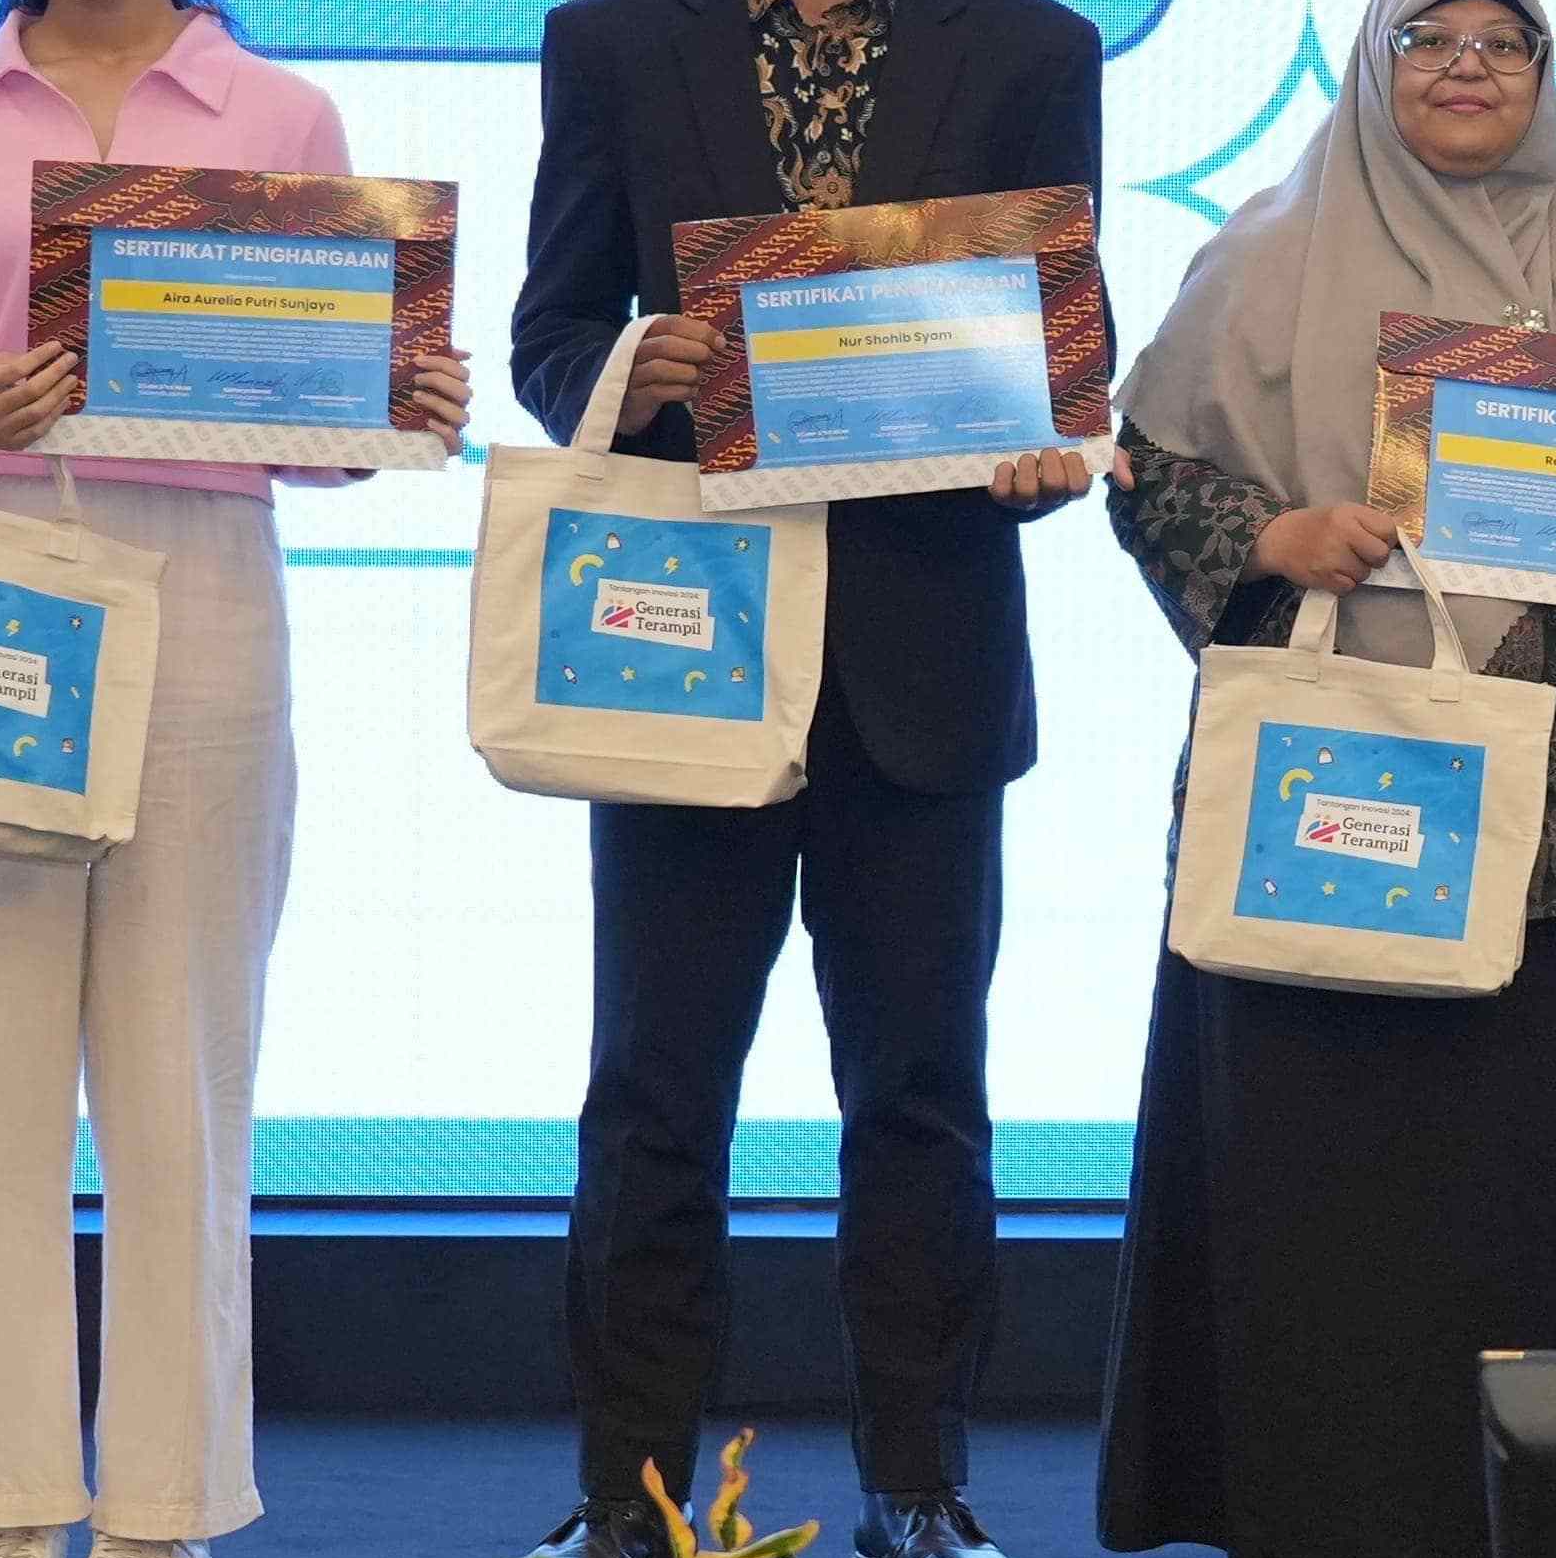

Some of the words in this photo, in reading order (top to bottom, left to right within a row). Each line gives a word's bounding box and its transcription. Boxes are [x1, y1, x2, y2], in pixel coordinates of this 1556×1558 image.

[113, 239, 227, 262] SERTIFIKAT
[231, 244, 389, 269] PENGHARGAAN
[245, 296, 277, 309] Putri
[756, 285, 865, 309] SERTIFIKAT
[839, 336, 862, 348] Nur
[636, 601, 701, 620] Generasi
[635, 616, 701, 637] Terampil
[1343, 817, 1411, 837] Generasi
[1341, 832, 1409, 853] Terampil
